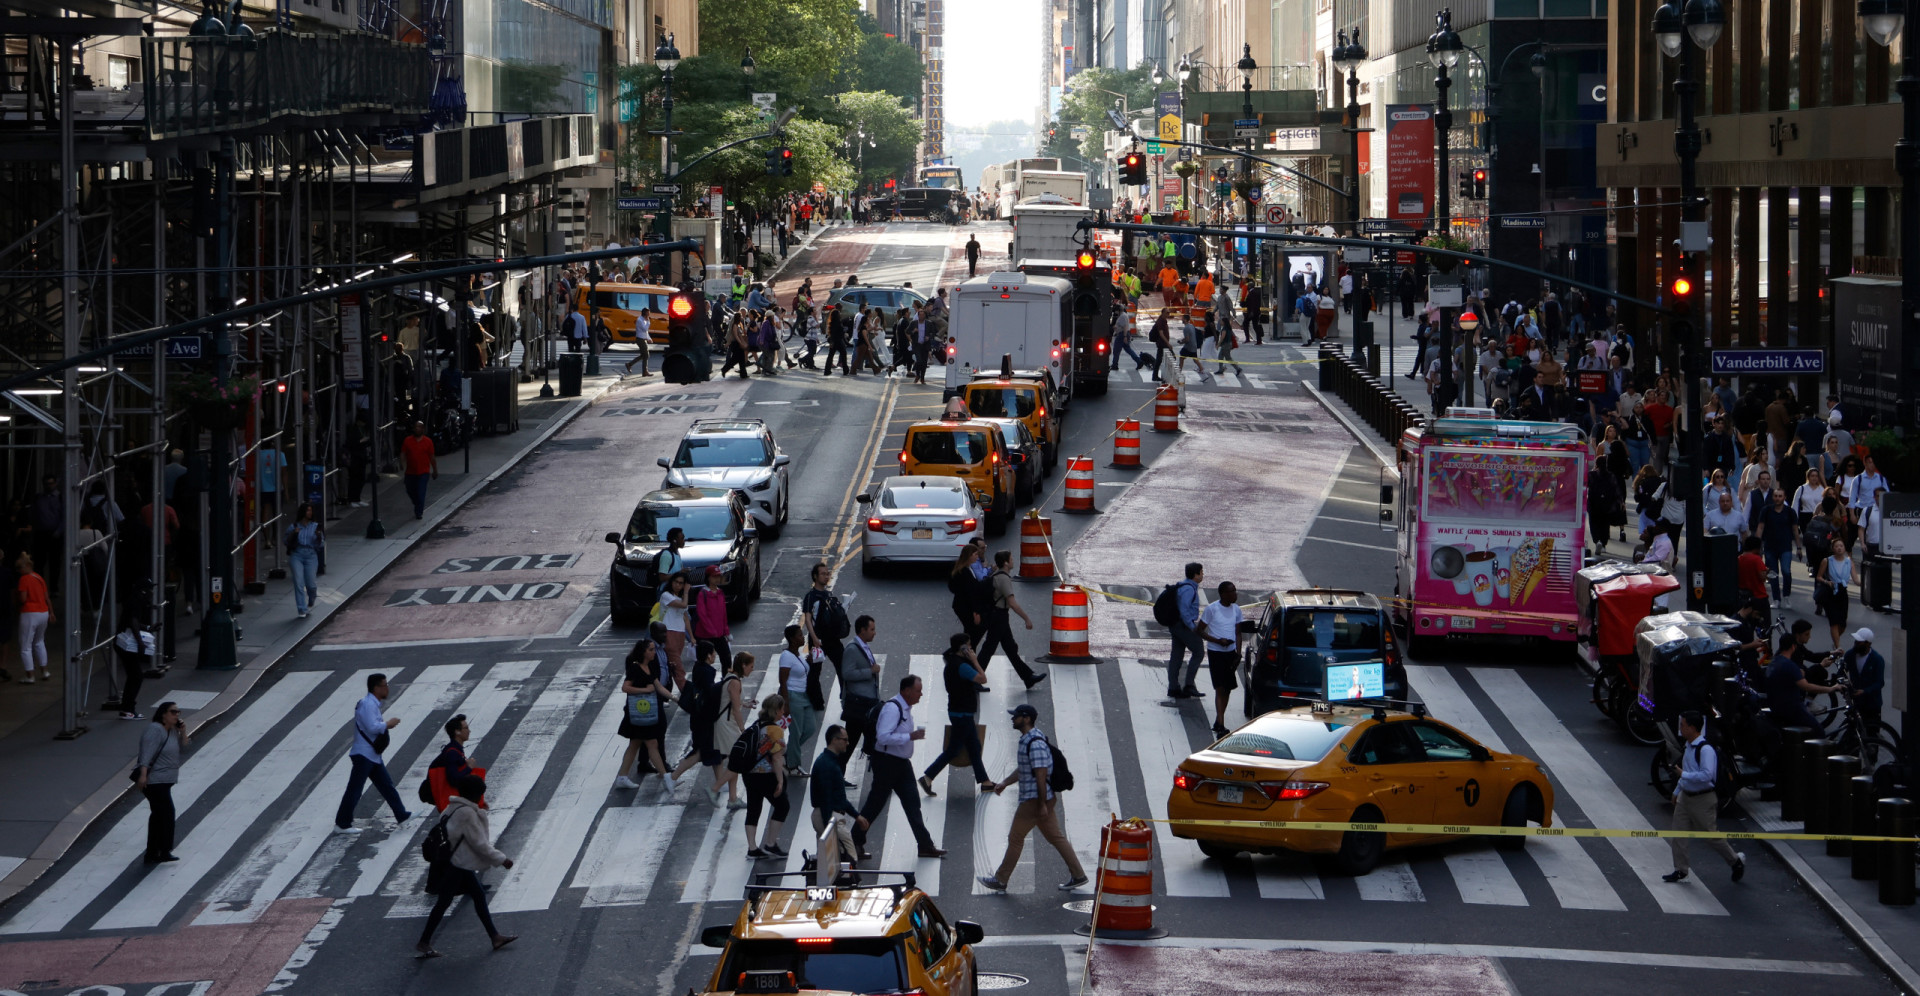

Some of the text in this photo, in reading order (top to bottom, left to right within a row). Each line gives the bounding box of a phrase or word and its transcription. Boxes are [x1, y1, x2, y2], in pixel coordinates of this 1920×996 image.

[931, 61, 941, 154] TUSSAUDS
[1162, 121, 1178, 134] Be
[1279, 129, 1318, 139] GEIGER
[1367, 222, 1387, 230] Madi
[1851, 320, 1888, 350] SUMMIT
[172, 342, 198, 354] Ave
[1715, 355, 1820, 368] Vanderbilt Ave
[1443, 461, 1566, 473] NEWYORKICECREAM.NYC
[1492, 529, 1522, 537] SUNDAES
[1525, 530, 1567, 538] MILKSHAKES
[438, 554, 582, 573] BUS
[383, 583, 565, 608] ONLY
[1312, 702, 1329, 711] 3Y95
[1240, 770, 1255, 779] 179
[1467, 784, 1477, 804] T
[808, 888, 833, 900] 9M76
[755, 975, 780, 988] 1B80
